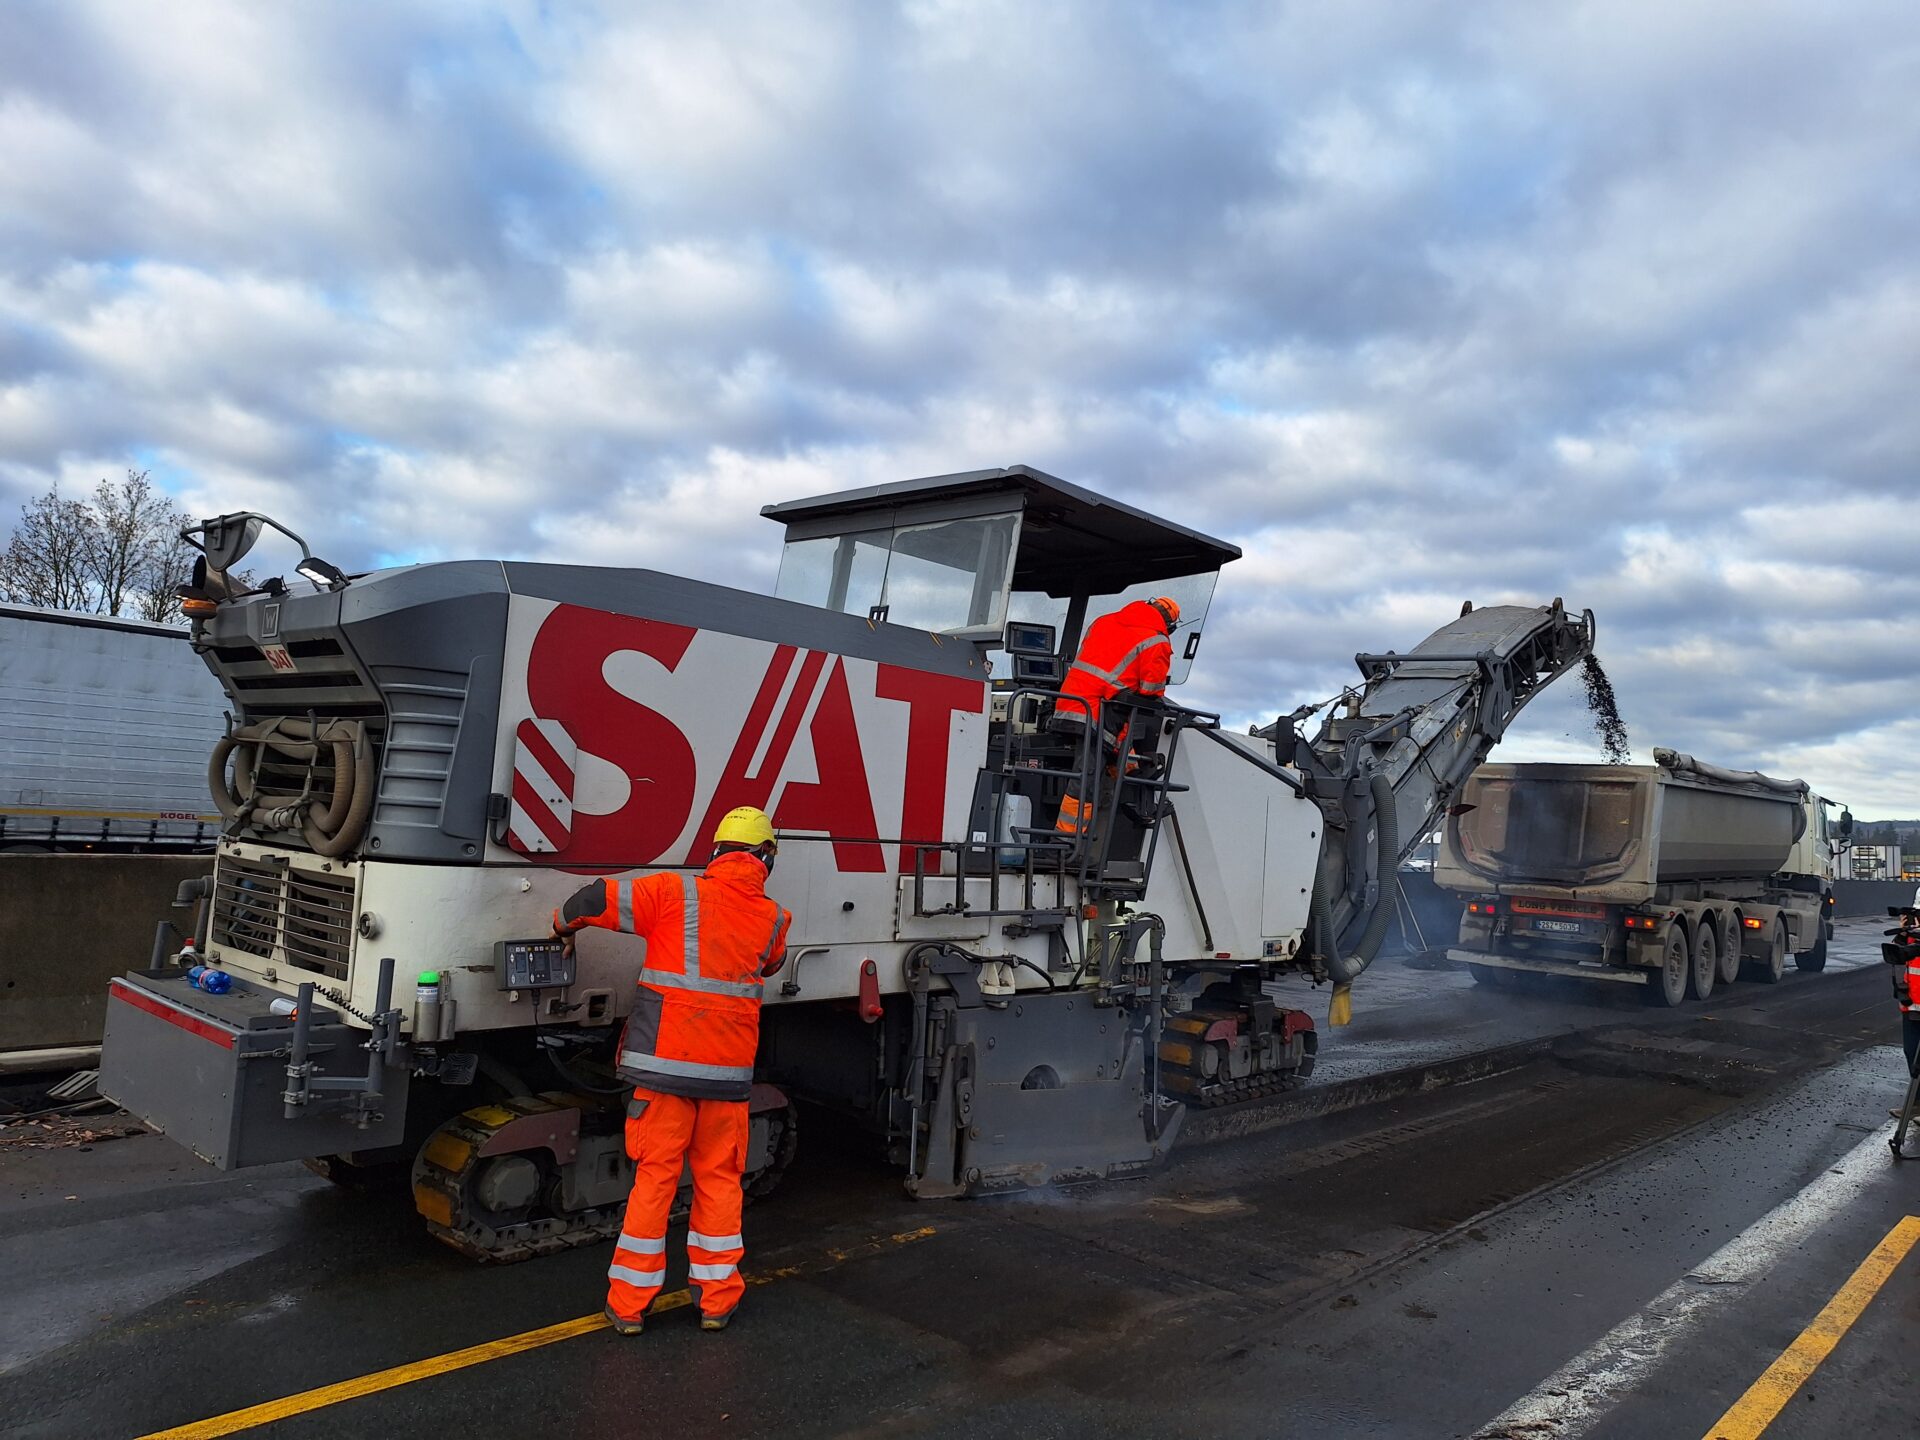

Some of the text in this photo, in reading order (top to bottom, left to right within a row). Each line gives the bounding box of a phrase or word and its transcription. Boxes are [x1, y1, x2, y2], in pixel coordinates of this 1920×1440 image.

[265, 611, 277, 630] W
[265, 649, 294, 669] SAT
[527, 603, 984, 874] SAT
[1518, 900, 1546, 910] LONG
